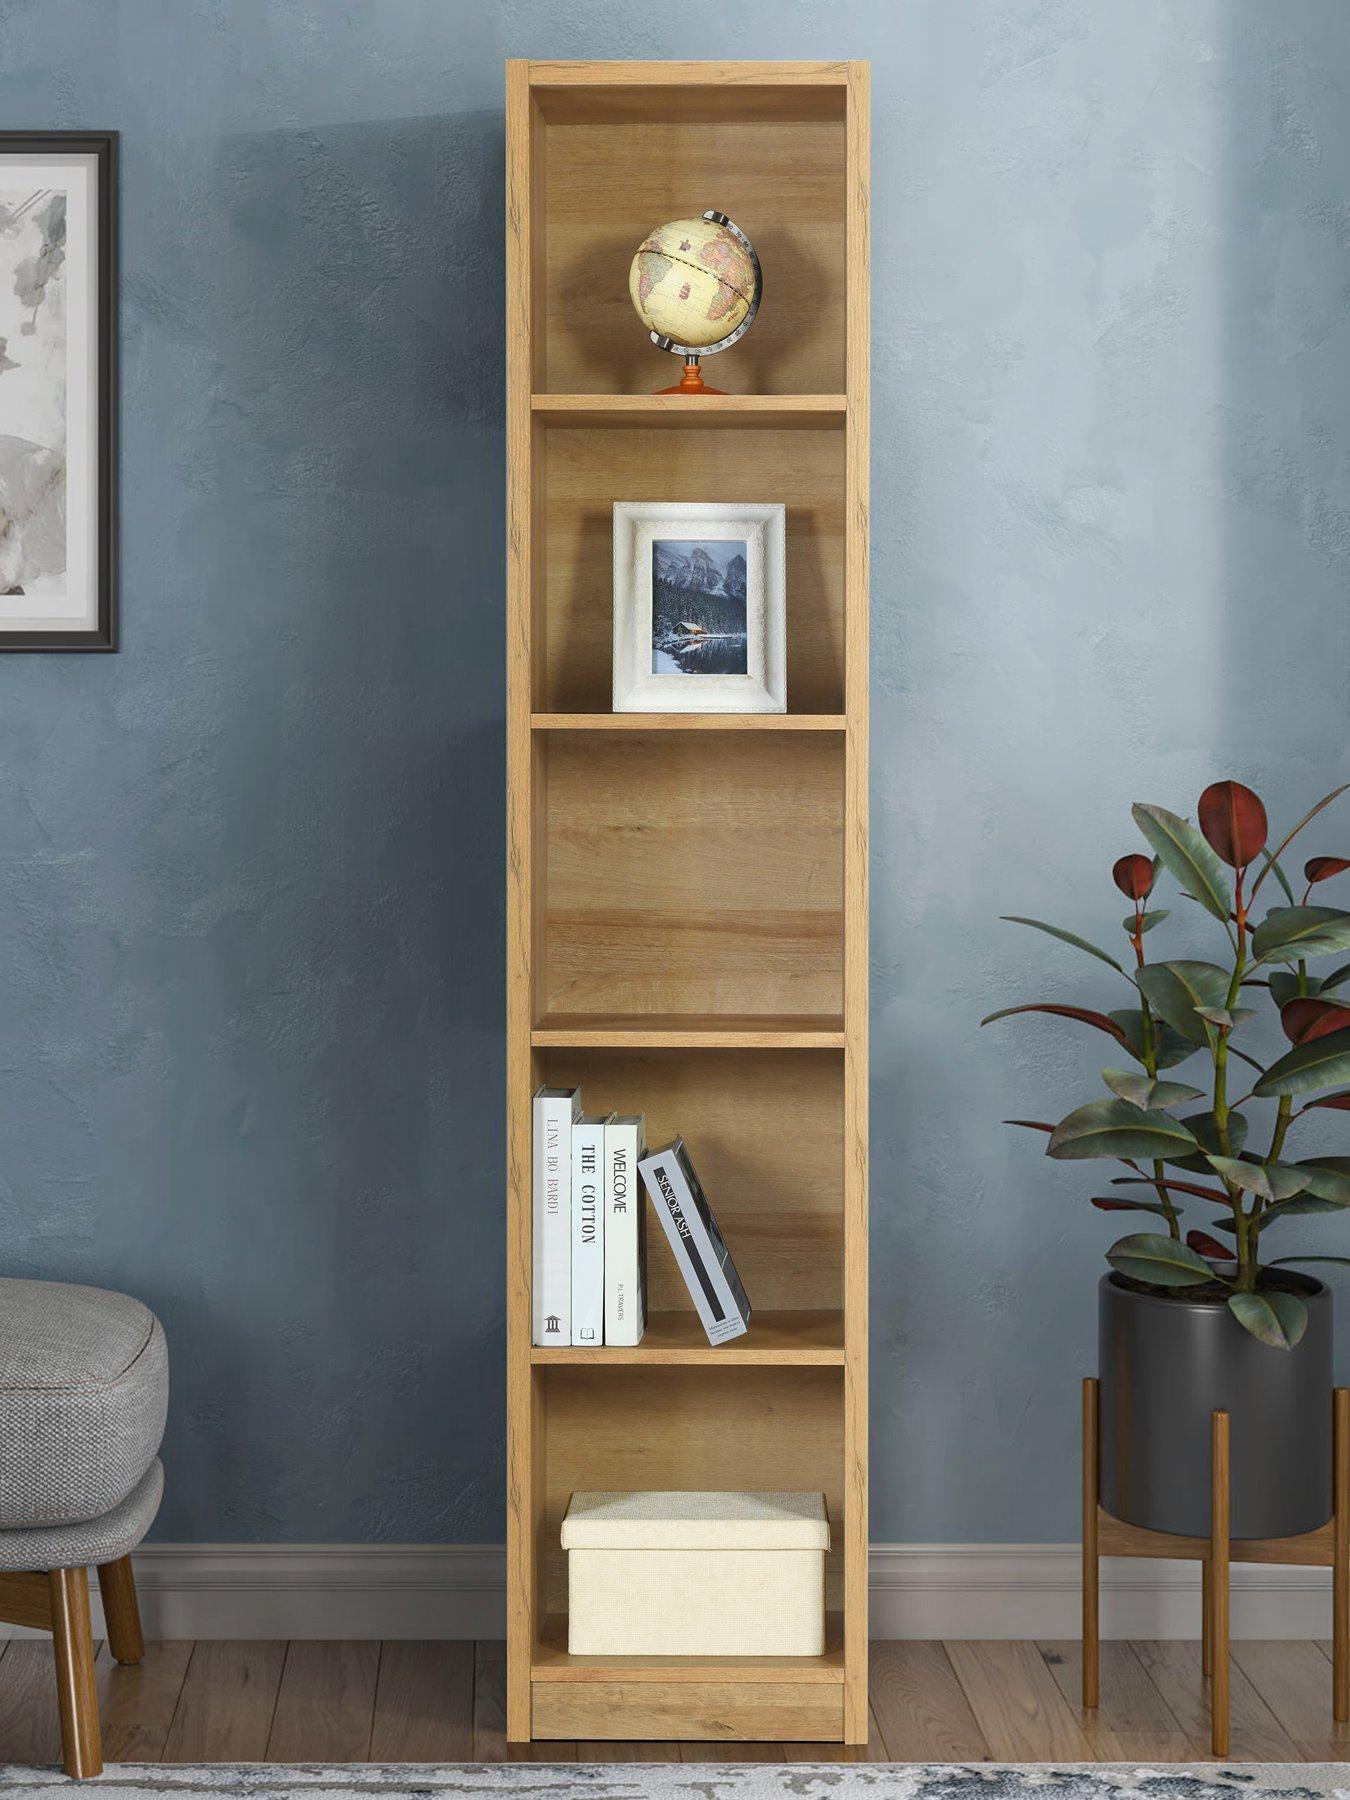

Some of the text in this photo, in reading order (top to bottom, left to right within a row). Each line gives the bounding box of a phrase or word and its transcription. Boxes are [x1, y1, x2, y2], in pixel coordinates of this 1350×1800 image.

[548, 1119, 558, 1215] LINA BO BARDI
[581, 1145, 595, 1244] THE COTTON
[613, 1148, 626, 1213] WELCOME
[657, 1174, 690, 1238] SENIOR ASH
